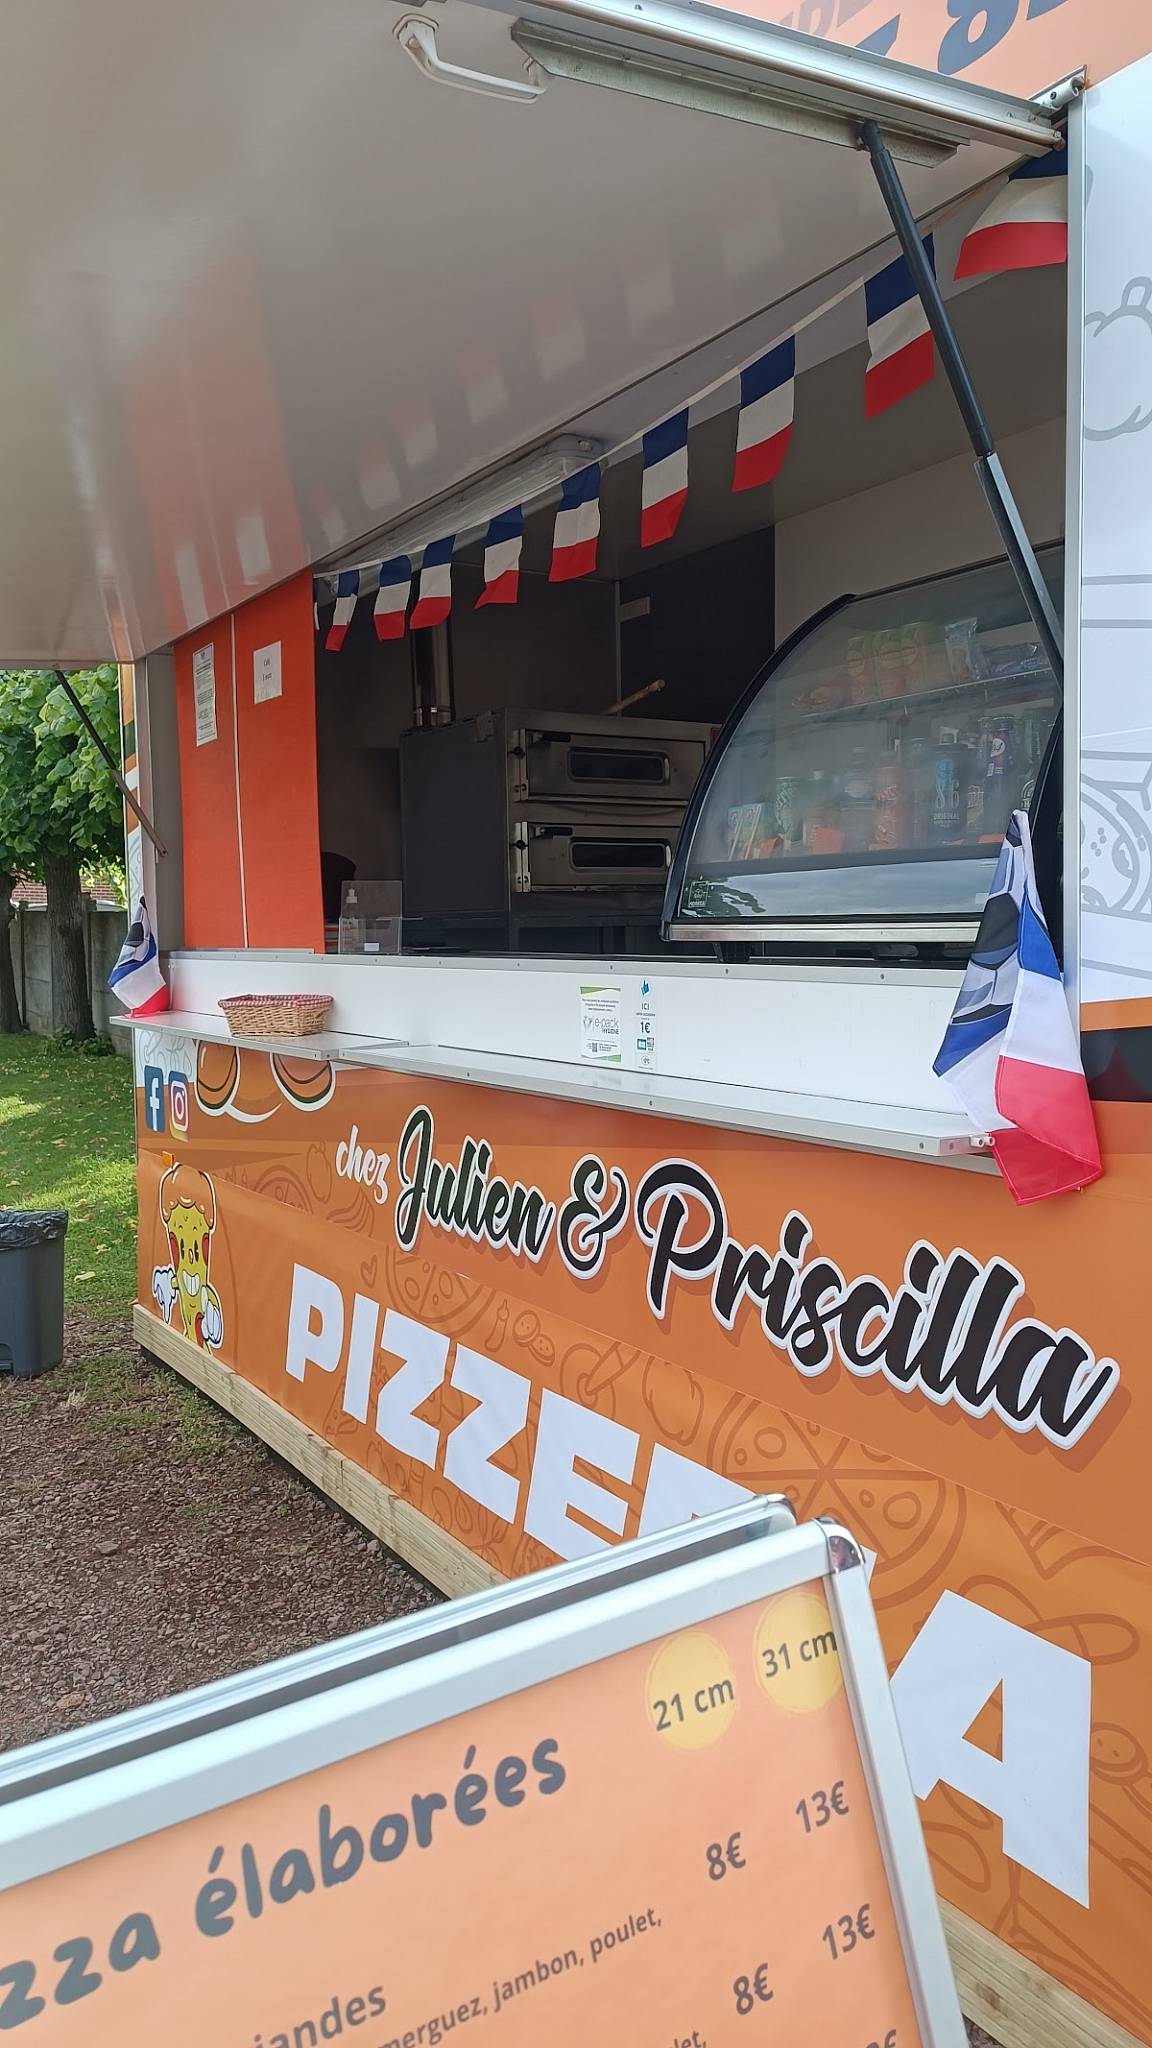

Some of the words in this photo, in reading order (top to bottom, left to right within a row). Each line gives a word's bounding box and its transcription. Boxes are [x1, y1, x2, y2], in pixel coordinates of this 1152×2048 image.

[641, 1003, 650, 1011] ICI
[641, 1021, 651, 1034] 1€
[335, 1124, 392, 1205] chez
[394, 1104, 556, 1263] Julien
[557, 1153, 631, 1280] &
[634, 1157, 1121, 1451] Priscilla
[761, 1643, 791, 1678] 31
[799, 1631, 838, 1664] cm
[653, 1694, 684, 1732] 21
[694, 1679, 735, 1714] cm
[195, 1738, 566, 1937] élaborées
[706, 1832, 746, 1881] 8€
[795, 1780, 849, 1834] 13€
[492, 1950, 585, 2012] jambon,
[588, 1908, 663, 1963] poulet,
[732, 1962, 773, 2015] 8€
[822, 1903, 875, 1960] 13€
